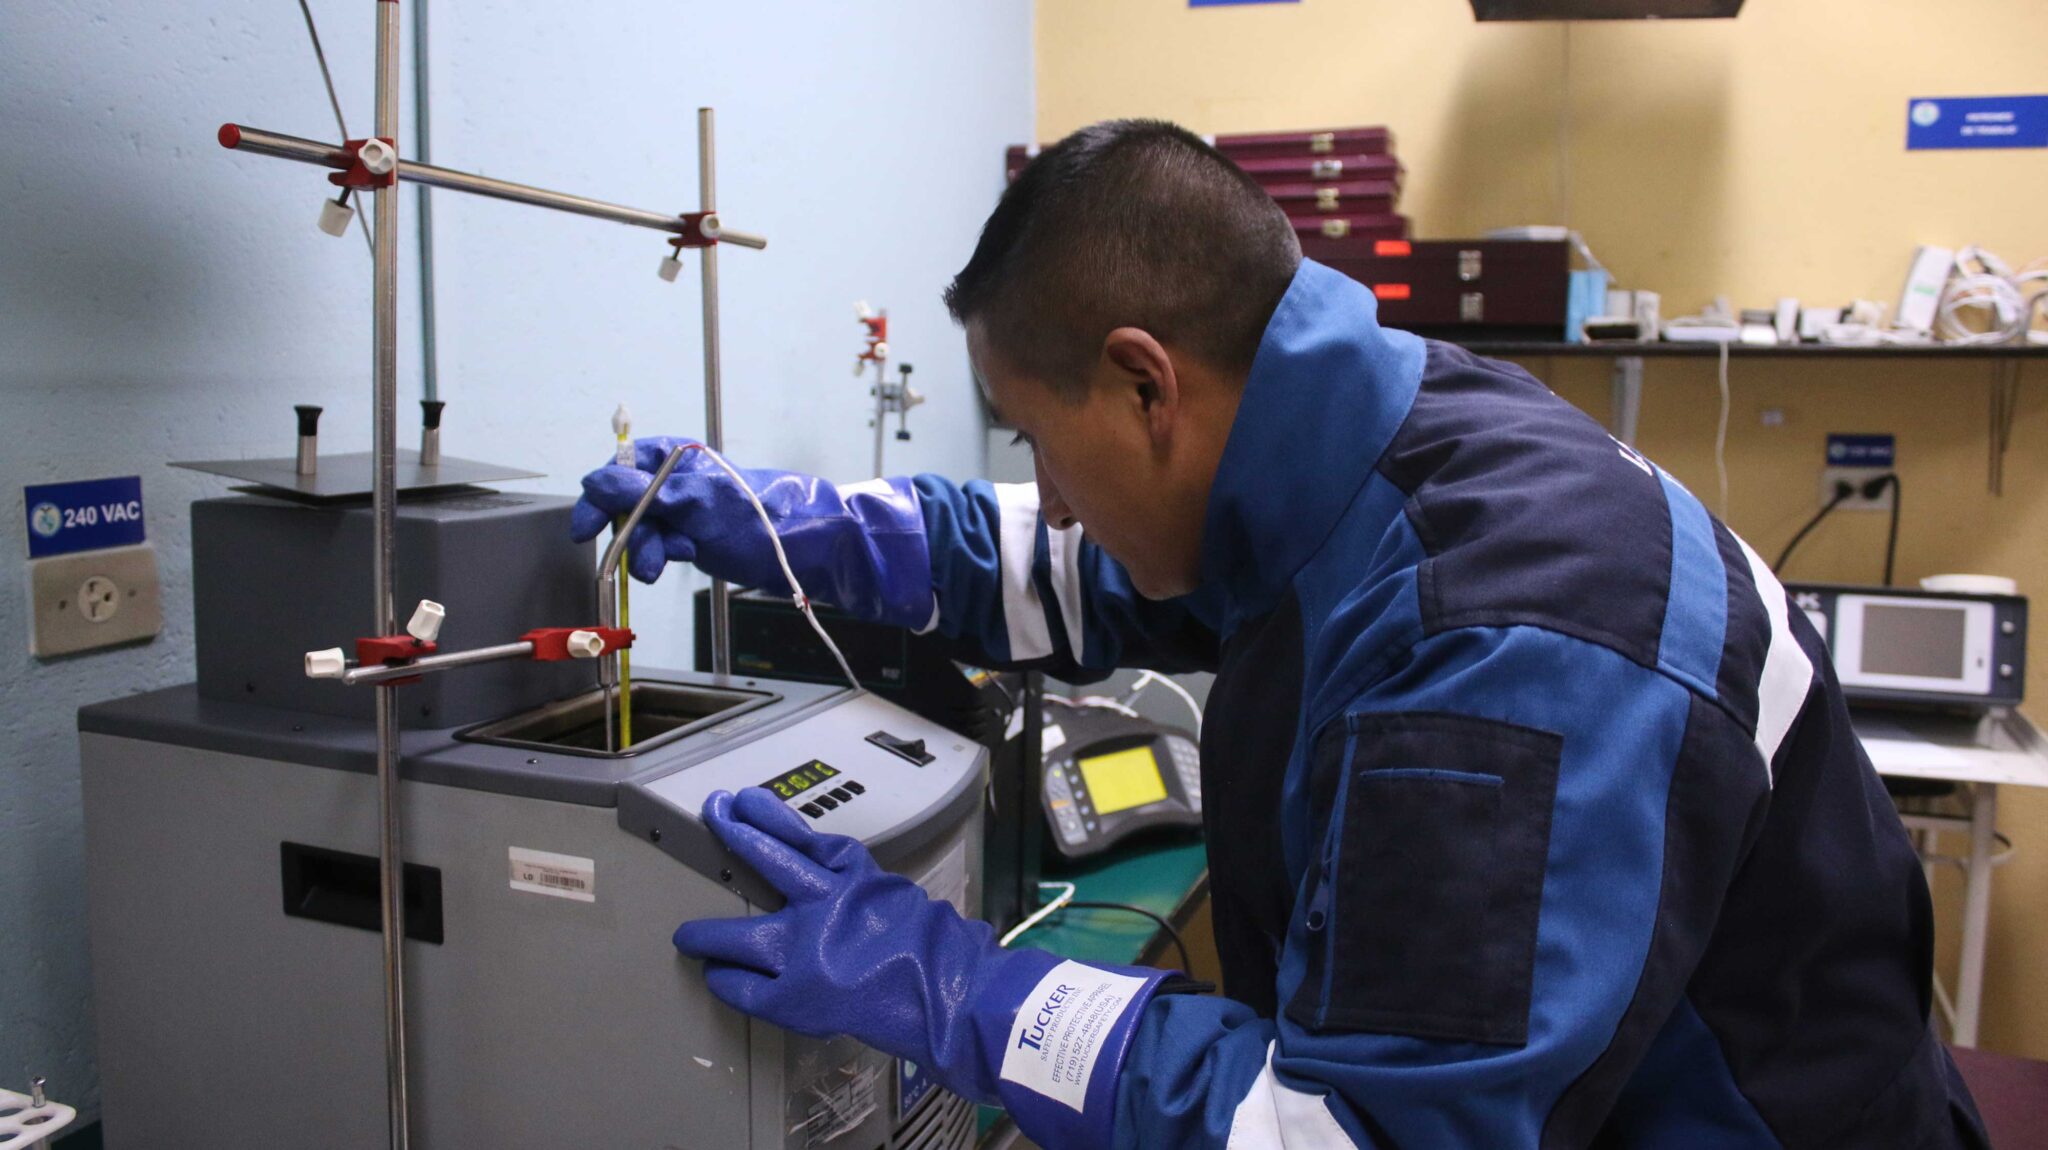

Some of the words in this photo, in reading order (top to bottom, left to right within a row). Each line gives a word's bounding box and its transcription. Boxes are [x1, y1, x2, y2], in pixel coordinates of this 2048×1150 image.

[64, 506, 98, 528] 240
[101, 501, 140, 523] VAC
[1040, 1032, 1054, 1061] SAFETY
[1050, 996, 1076, 1032] PRODUCTS
[1052, 1041, 1068, 1084] EFFECTIVE
[1062, 999, 1092, 1042] PROTECTIVE
[1065, 1056, 1080, 1082] (719)
